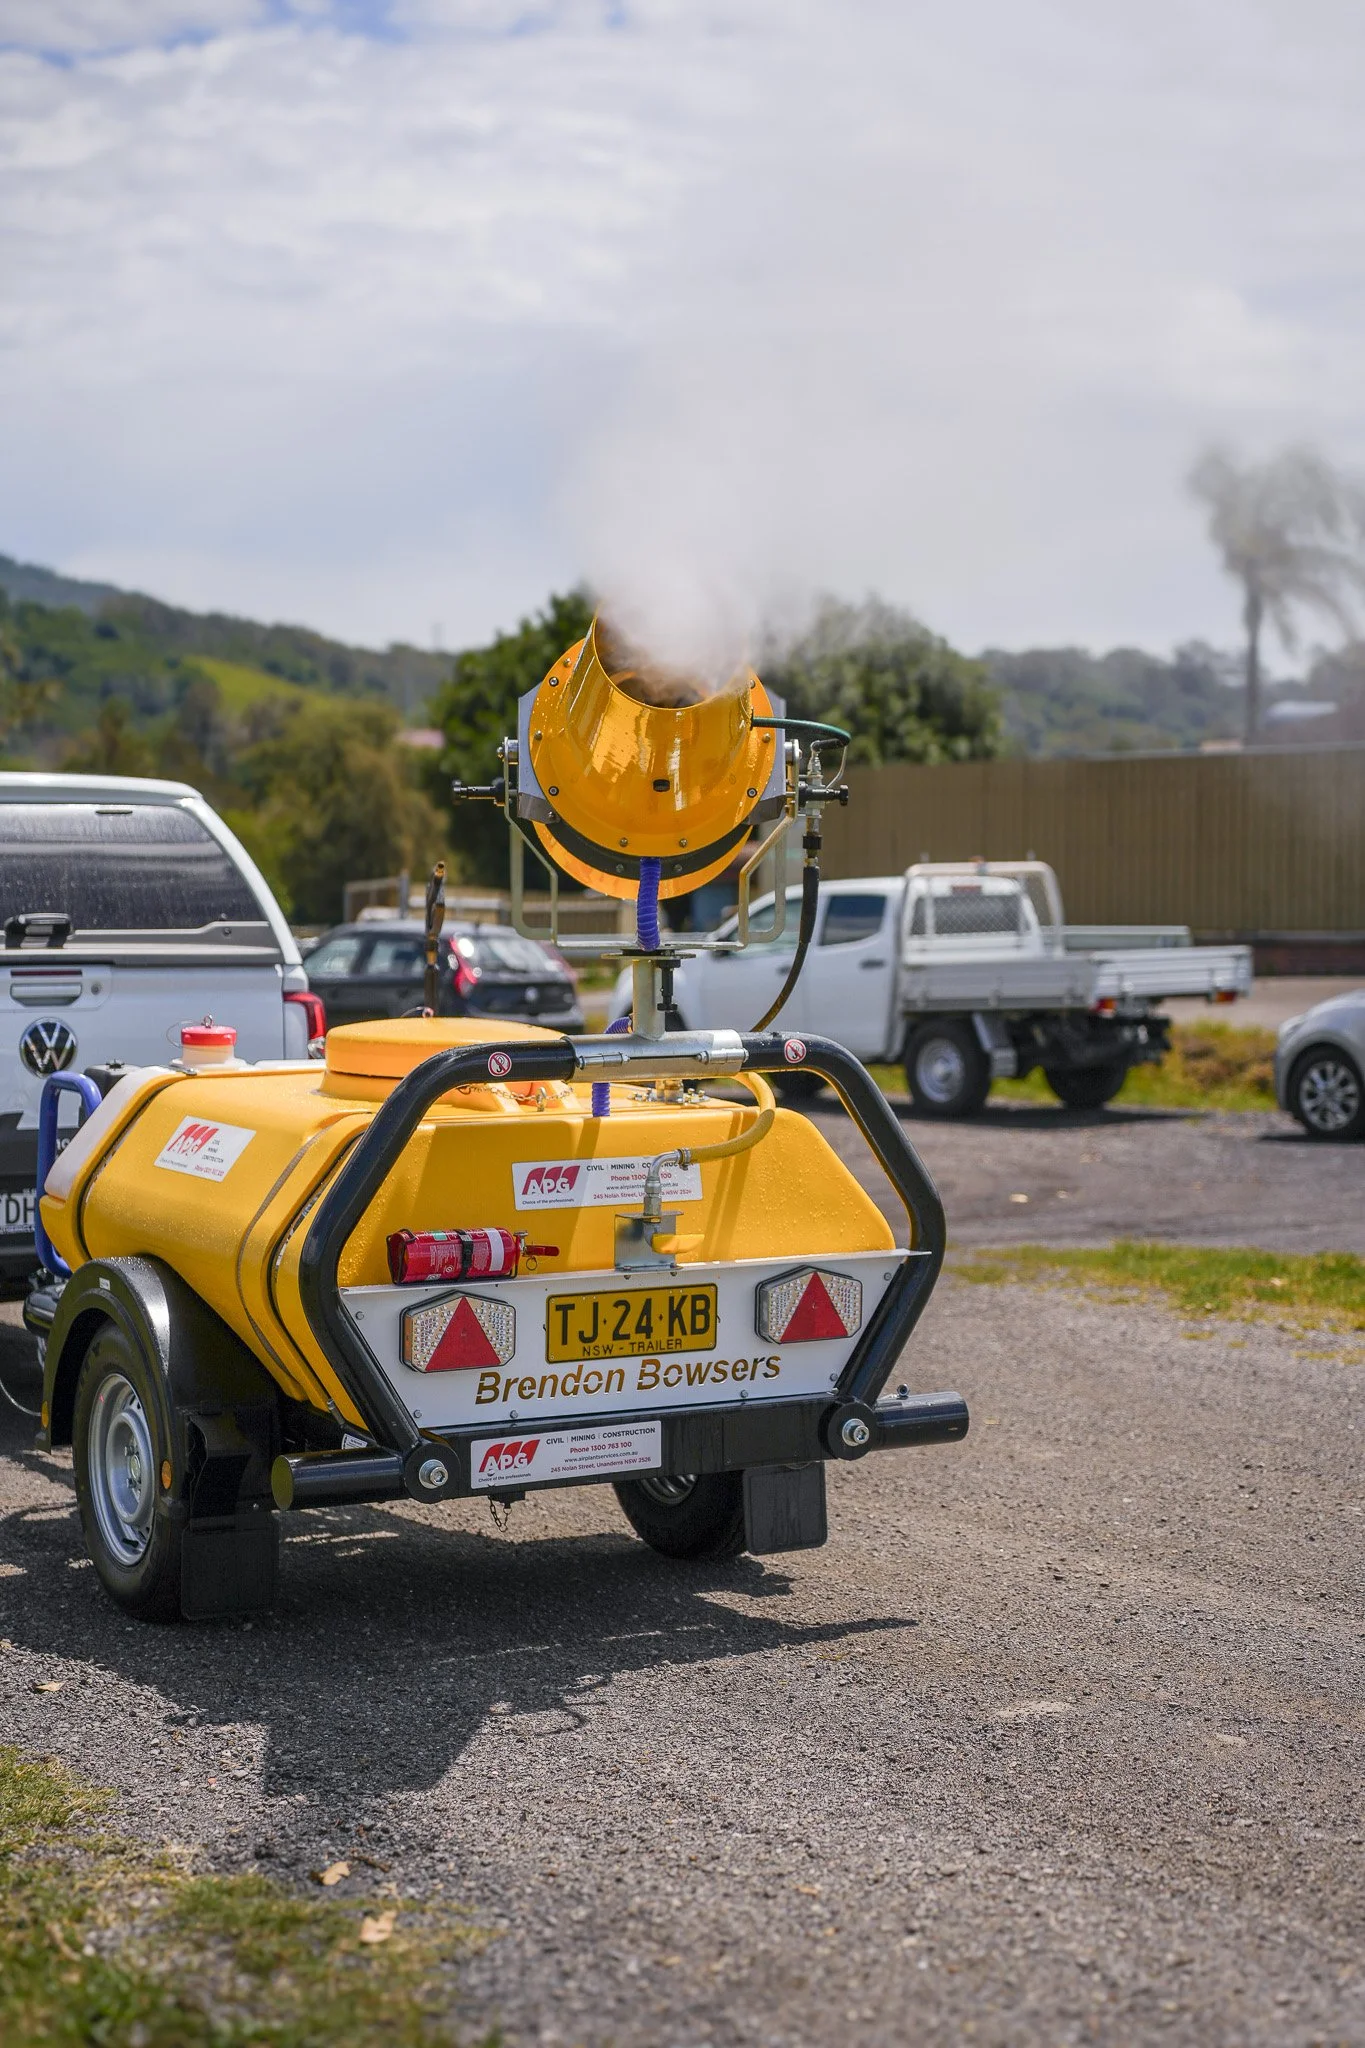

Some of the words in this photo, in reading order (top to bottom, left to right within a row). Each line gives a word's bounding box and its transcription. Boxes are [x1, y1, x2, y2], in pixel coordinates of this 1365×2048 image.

[582, 1343, 614, 1357] NSW
[629, 1338, 682, 1353] TRAILER
[475, 1364, 626, 1406] Brendon
[636, 1354, 782, 1392] Bowsers
[545, 1437, 564, 1445] CIVIL
[570, 1433, 596, 1442] MINING
[602, 1427, 656, 1439] CONSTRUCTION
[569, 1446, 589, 1454] Phone
[591, 1444, 606, 1452] 1300
[561, 1464, 577, 1472] Nolan
